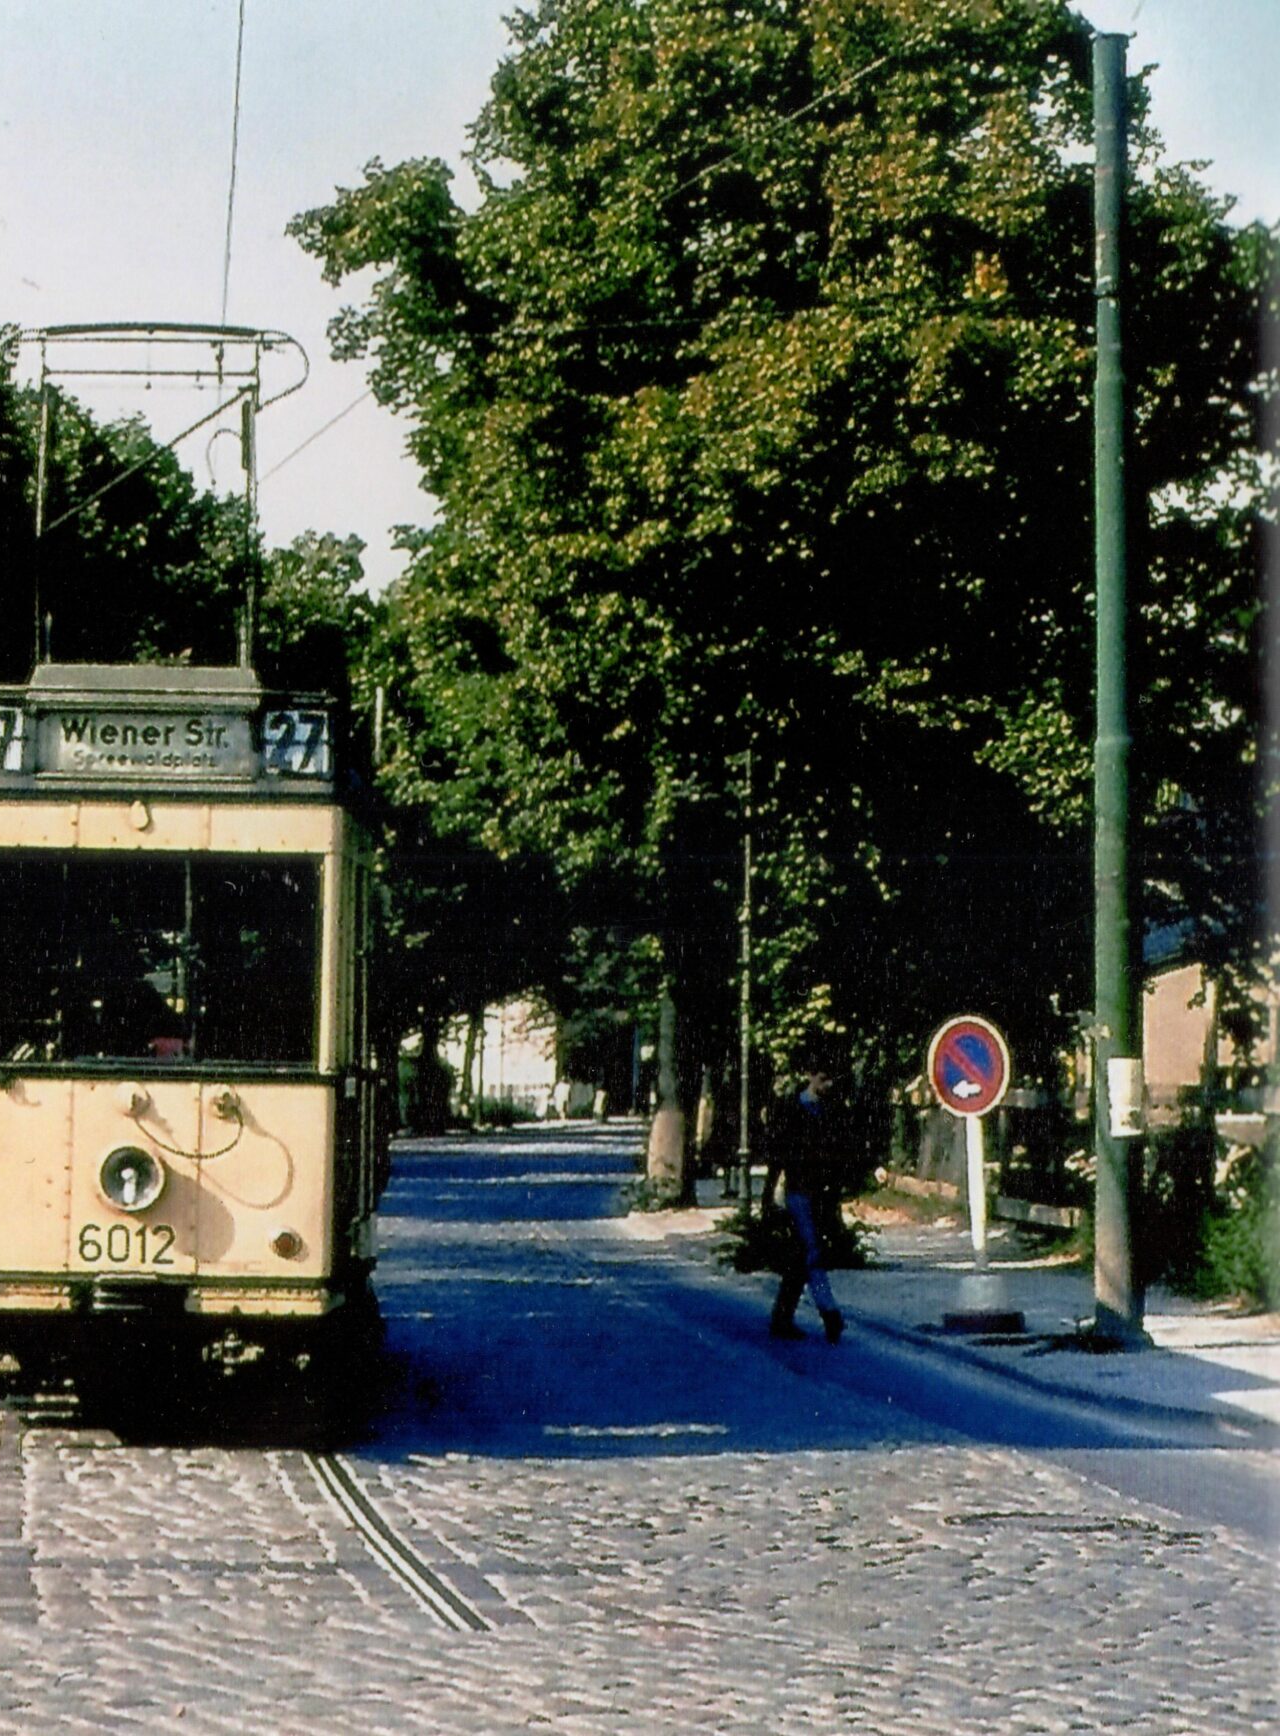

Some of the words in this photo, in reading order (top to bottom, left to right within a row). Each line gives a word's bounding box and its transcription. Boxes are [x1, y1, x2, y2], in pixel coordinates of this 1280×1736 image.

[61, 715, 175, 746] Wiener
[185, 718, 230, 749] Str.
[268, 713, 325, 770] 27
[78, 1223, 176, 1265] 6012
